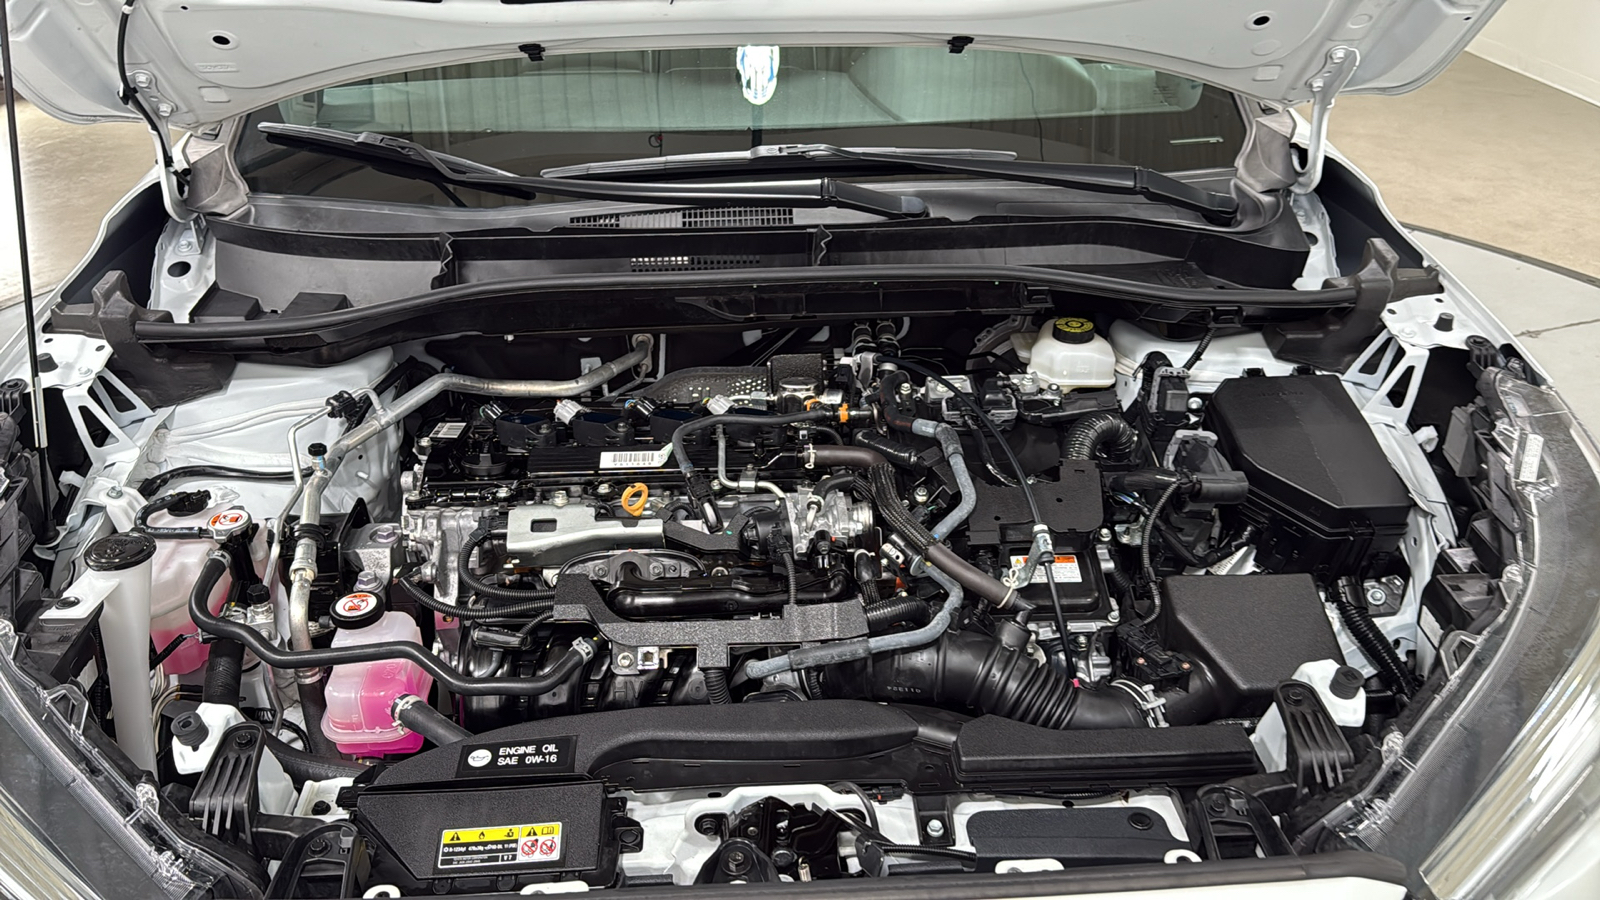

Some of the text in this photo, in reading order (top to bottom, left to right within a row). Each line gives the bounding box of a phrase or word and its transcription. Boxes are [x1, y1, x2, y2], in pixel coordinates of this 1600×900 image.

[498, 744, 559, 755] ENGINE OIL
[497, 754, 557, 766] SAE 0W-16
